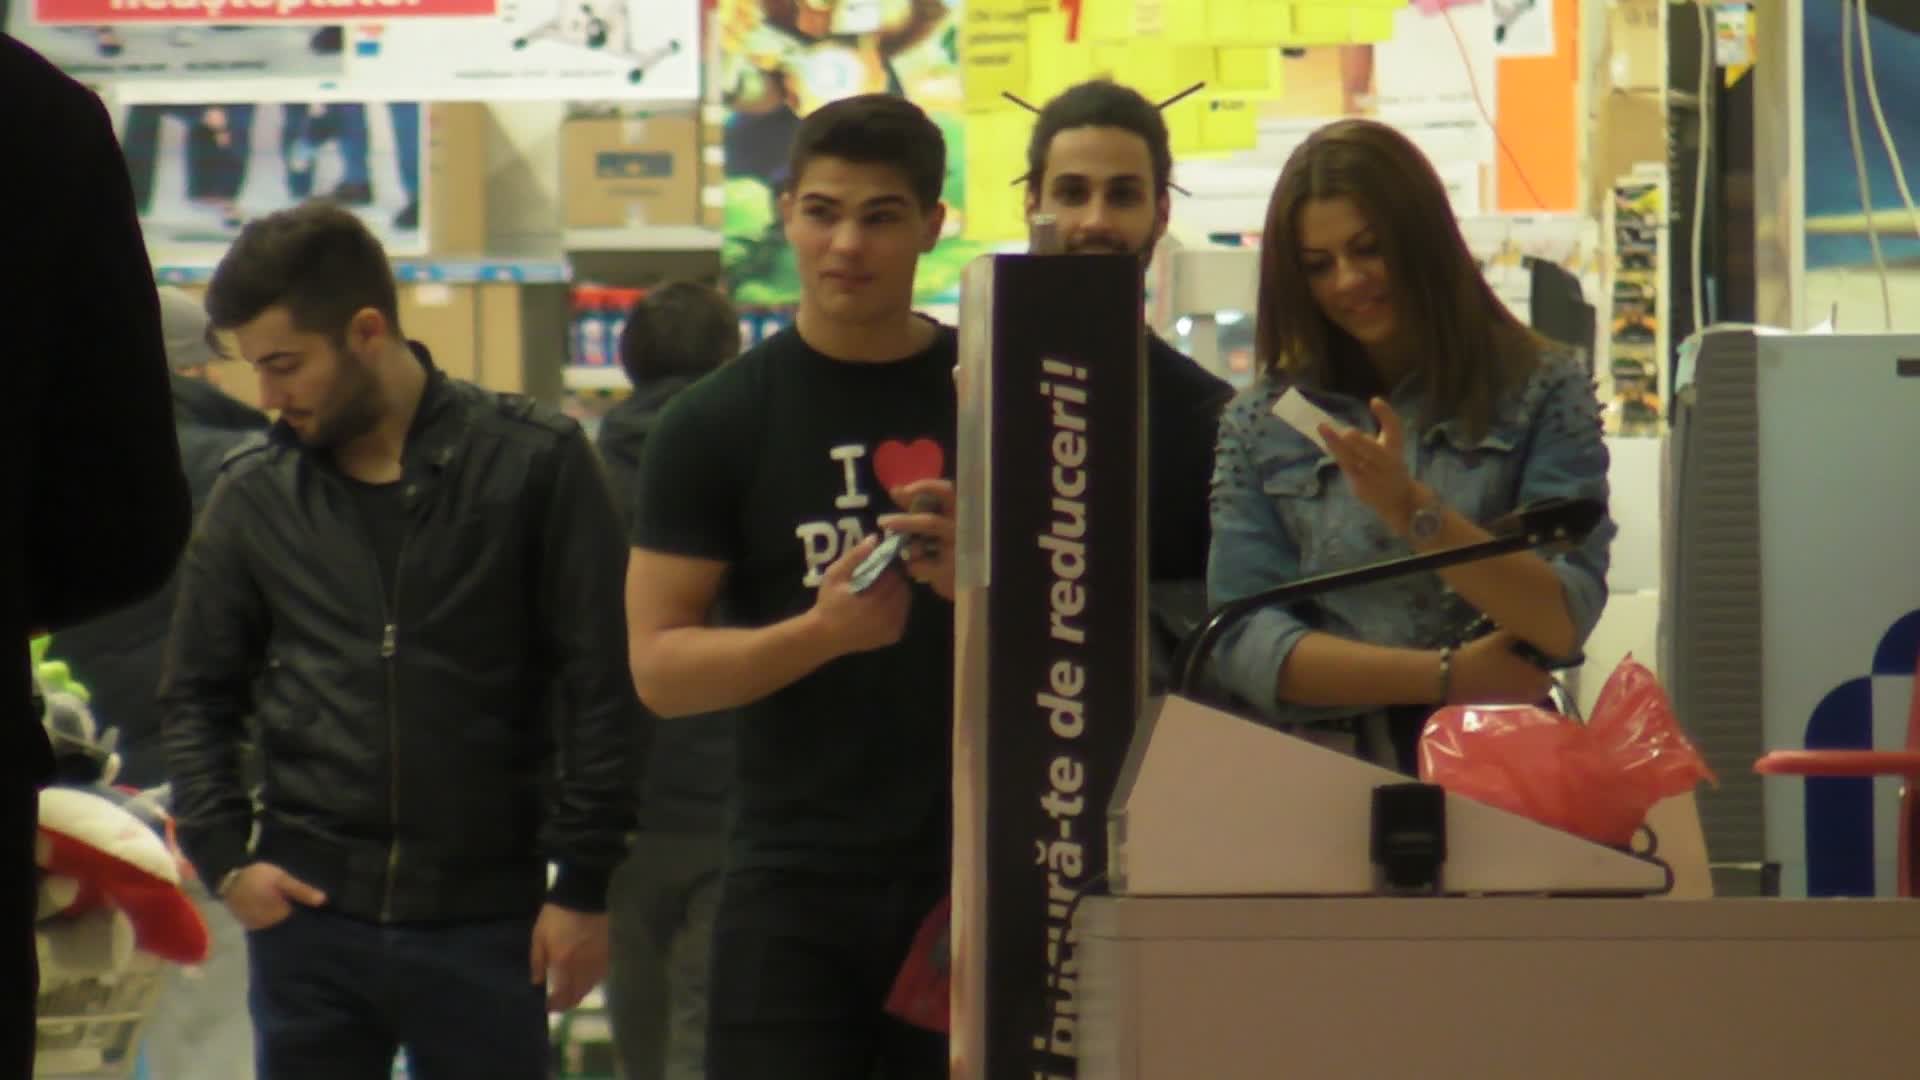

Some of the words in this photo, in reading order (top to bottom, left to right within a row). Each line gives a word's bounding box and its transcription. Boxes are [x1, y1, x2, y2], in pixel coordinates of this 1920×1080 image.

[829, 444, 869, 509] I
[1037, 357, 1088, 644] reduceri!
[1036, 660, 1086, 739] de
